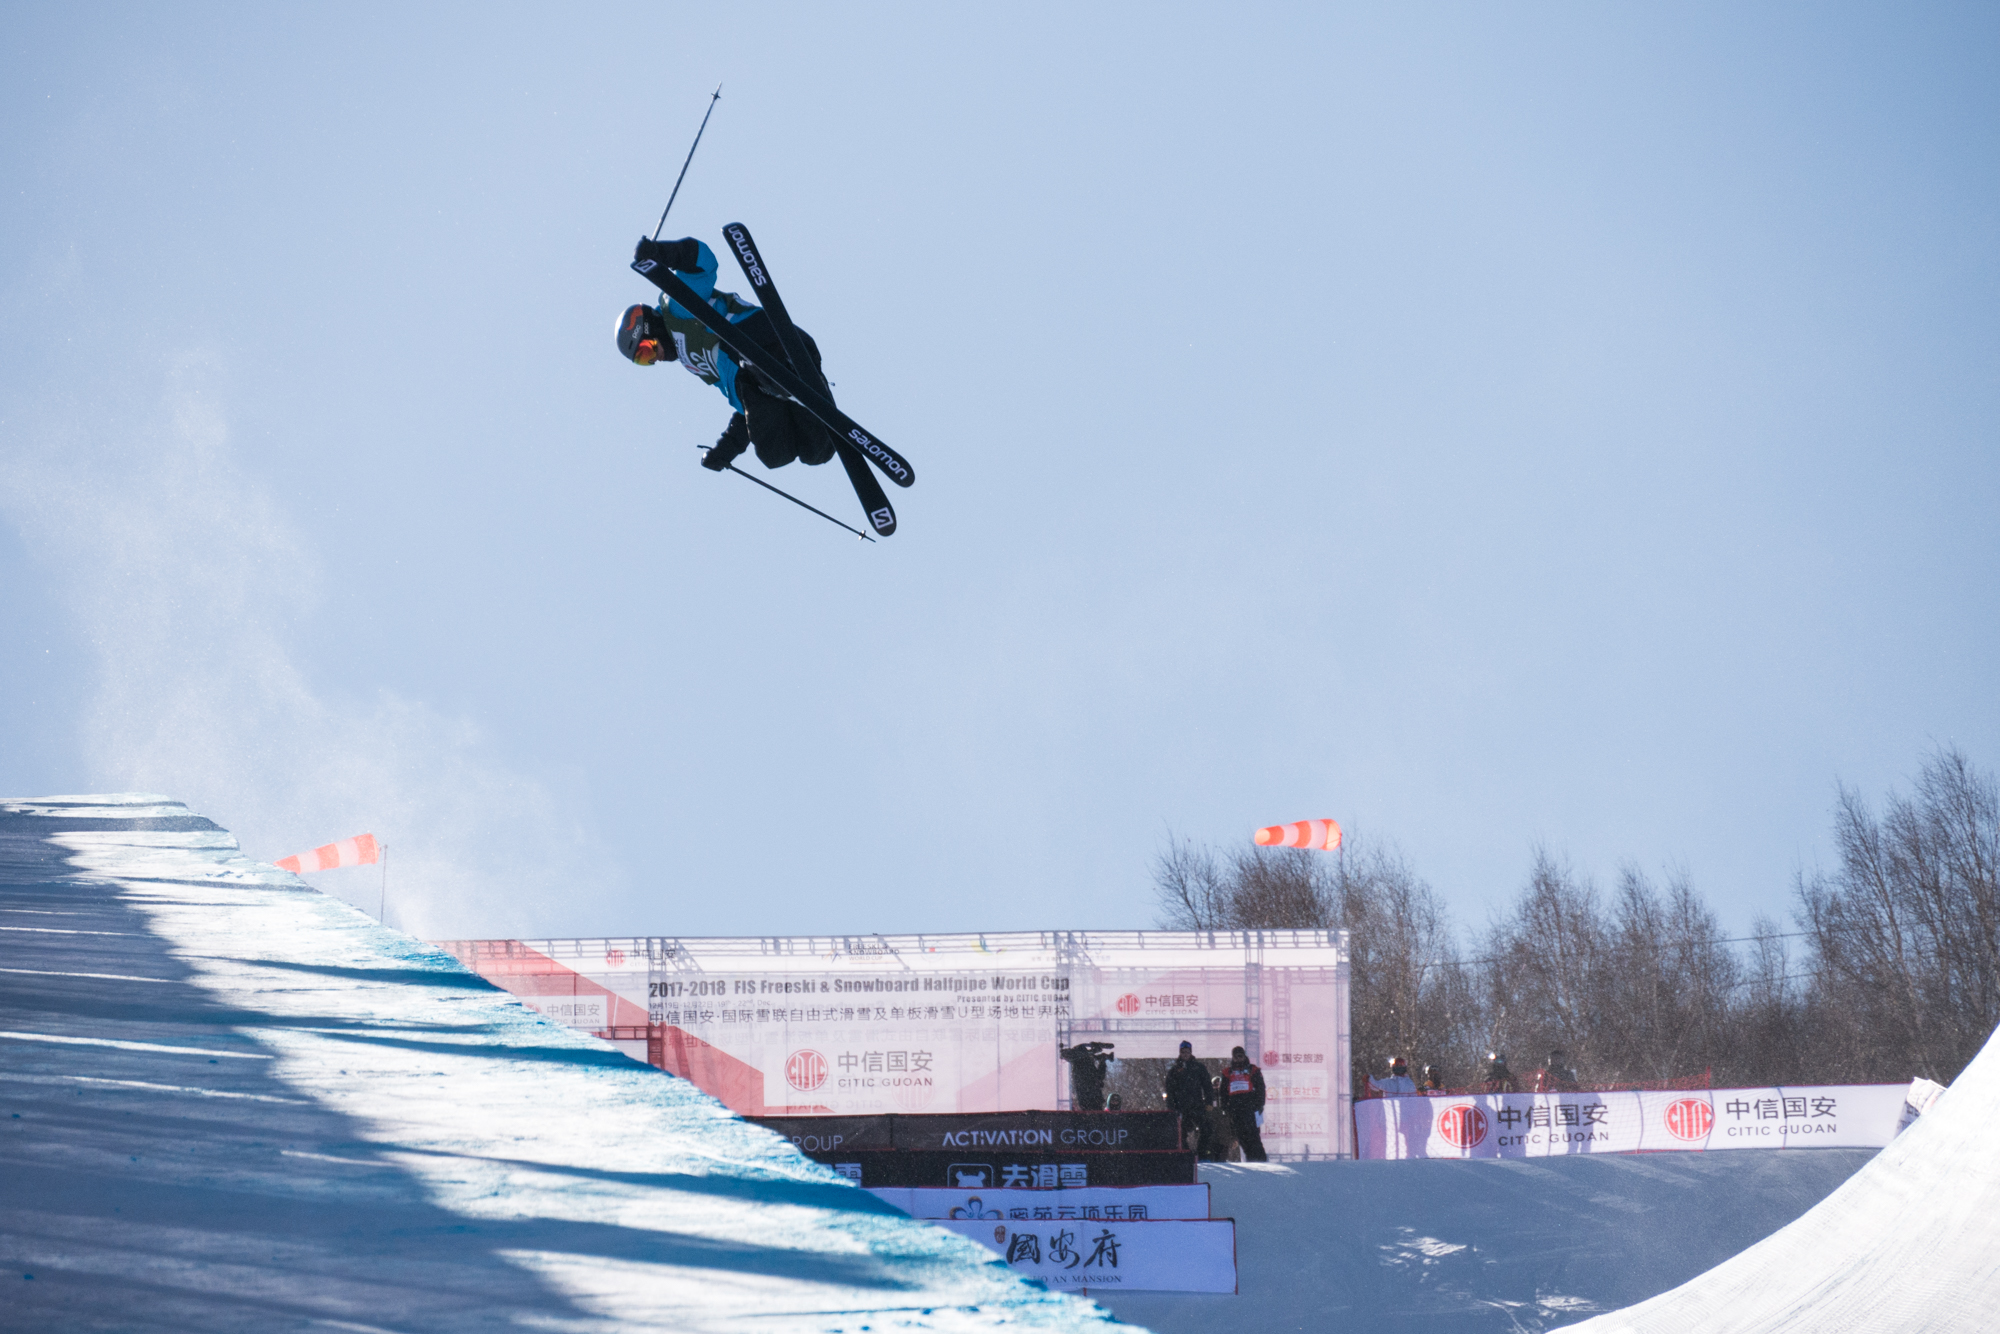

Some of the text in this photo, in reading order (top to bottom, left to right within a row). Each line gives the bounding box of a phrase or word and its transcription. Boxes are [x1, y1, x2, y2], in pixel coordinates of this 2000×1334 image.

[649, 975, 1070, 998] 2017-2018 FIS Freeski & Snowboard Halfpipe World Cup
[1145, 994, 1199, 1007] 中信国安
[546, 1003, 600, 1016] 中信国安
[837, 1050, 934, 1073] 中信国安
[838, 1077, 933, 1088] CITIC GUOAN
[1497, 1102, 1609, 1130] 中信国安
[1726, 1096, 1837, 1121] 中信国安
[942, 1128, 1128, 1146] ACTIVATION GROUP
[1727, 1124, 1837, 1137] CITIC GUOAN
[792, 1135, 844, 1151] ROUP
[1498, 1131, 1609, 1147] CITIC GUOAN
[1002, 1163, 1088, 1188] 去滑雪
[1053, 1275, 1067, 1283] AN
[1072, 1275, 1122, 1283] MANSION
